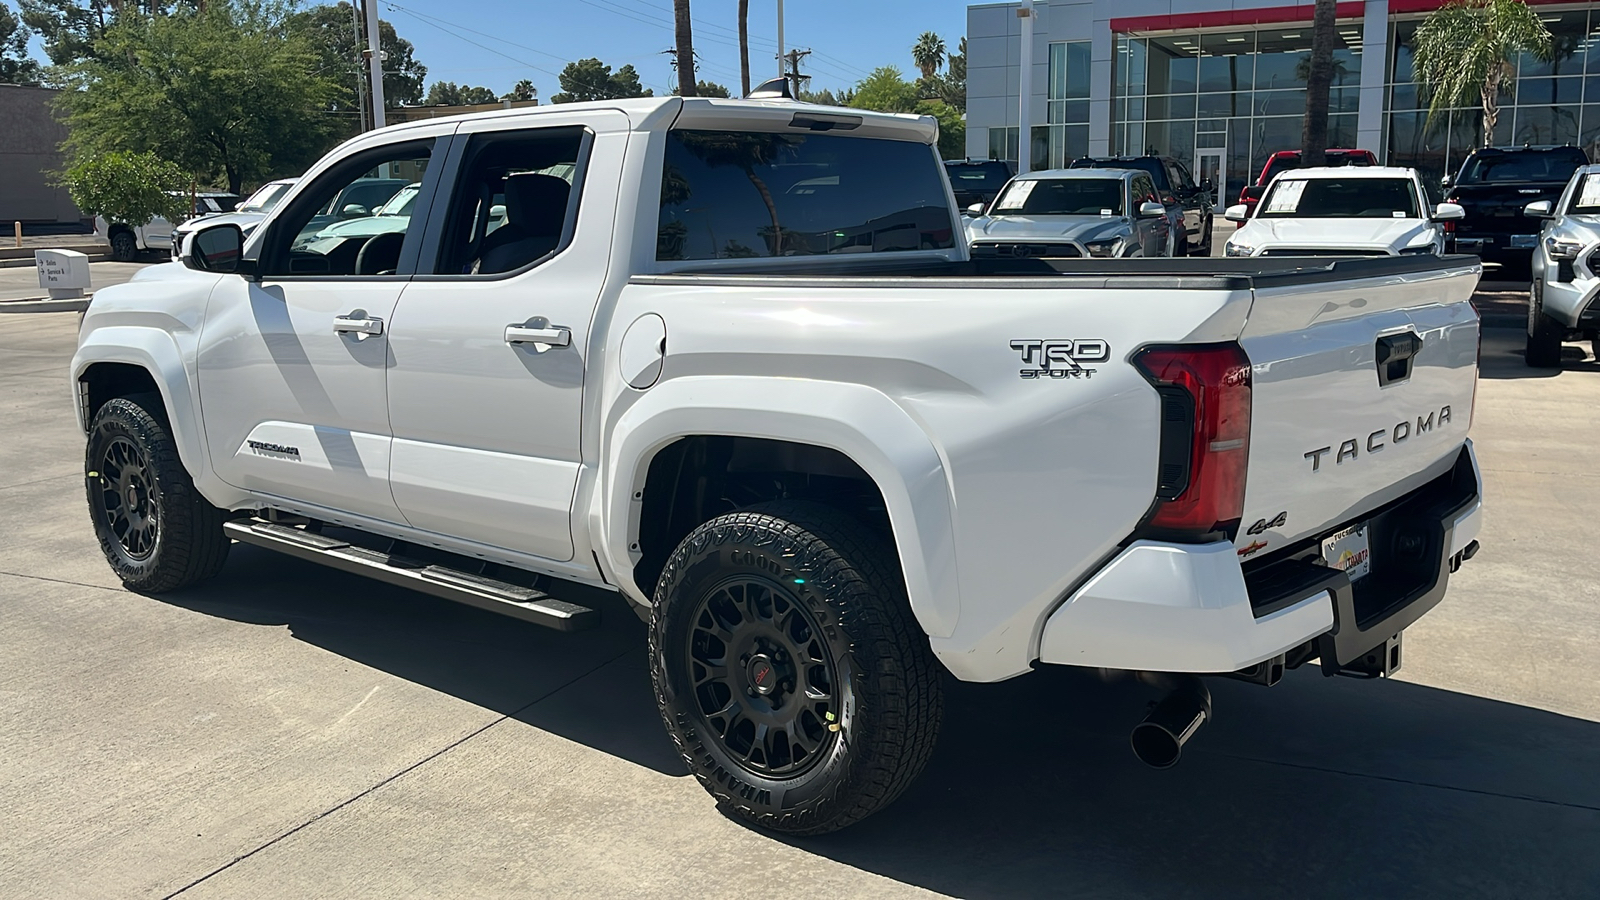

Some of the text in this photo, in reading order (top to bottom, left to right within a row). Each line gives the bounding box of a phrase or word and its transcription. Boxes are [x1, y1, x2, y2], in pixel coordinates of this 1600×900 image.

[1010, 339, 1111, 370] TRD
[1020, 369, 1097, 379] SPORT
[247, 440, 300, 457] TACOMA
[1304, 405, 1451, 473] TACOMA
